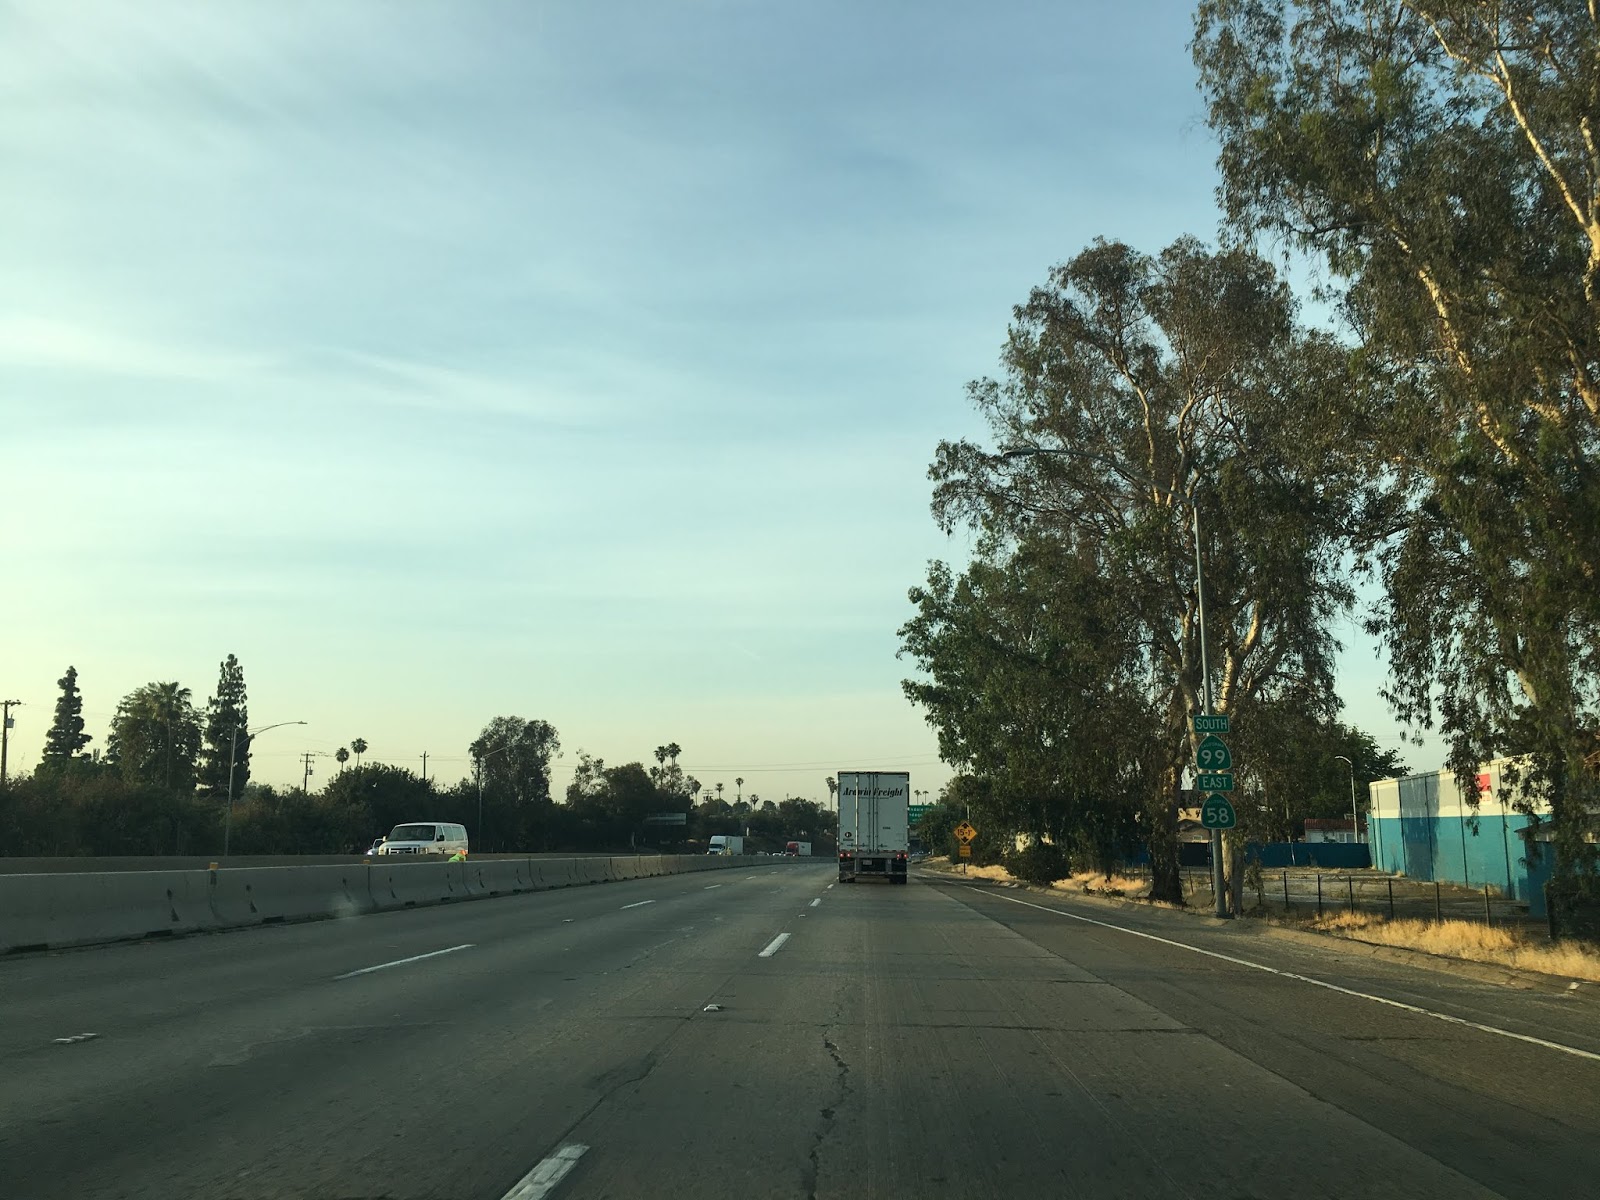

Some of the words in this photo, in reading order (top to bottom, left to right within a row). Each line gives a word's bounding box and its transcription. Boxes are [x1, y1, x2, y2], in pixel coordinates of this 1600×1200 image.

[1195, 719, 1228, 730] SOUTH
[1201, 749, 1225, 765] 99
[1202, 776, 1228, 788] EAST
[873, 787, 904, 798] Freight
[1207, 807, 1230, 824] 58
